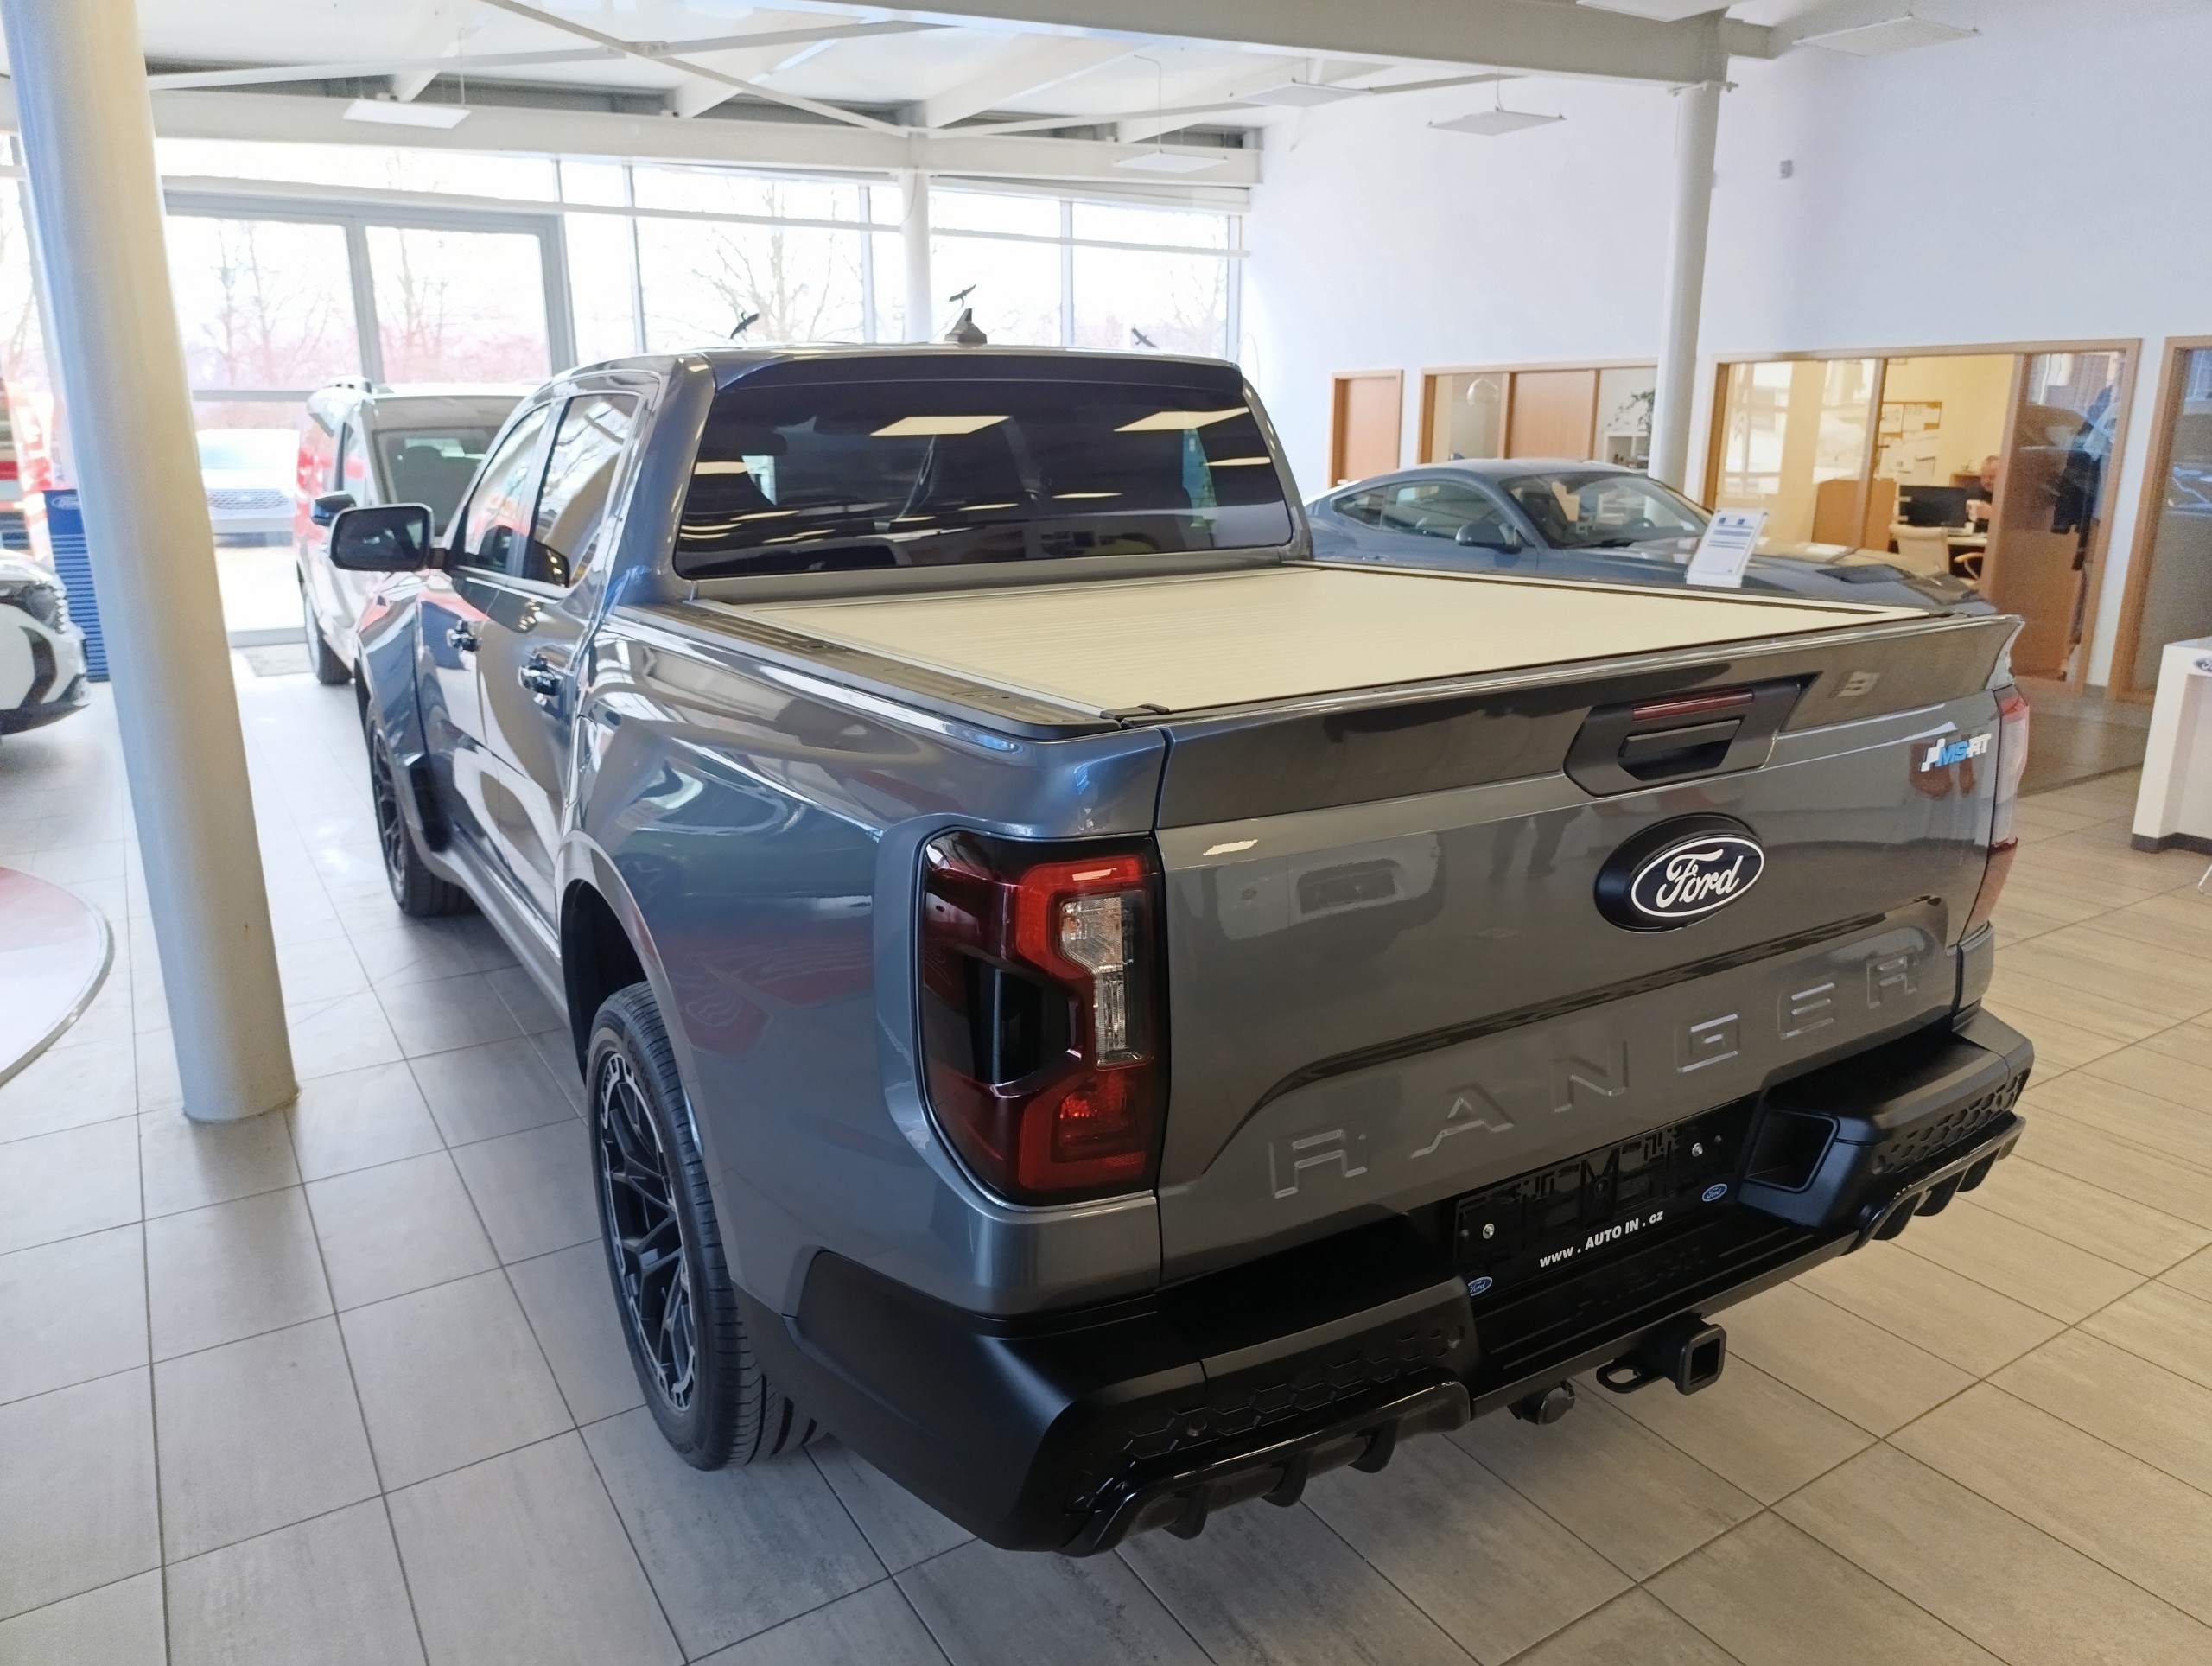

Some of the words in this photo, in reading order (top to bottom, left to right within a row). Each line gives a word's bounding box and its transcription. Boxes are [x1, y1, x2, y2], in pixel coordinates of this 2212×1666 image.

[1656, 849, 1744, 908] Ford
[1269, 954, 1918, 1199] RANGER
[1585, 1225, 1622, 1250] AUTO
[1624, 1218, 1639, 1234] IN
